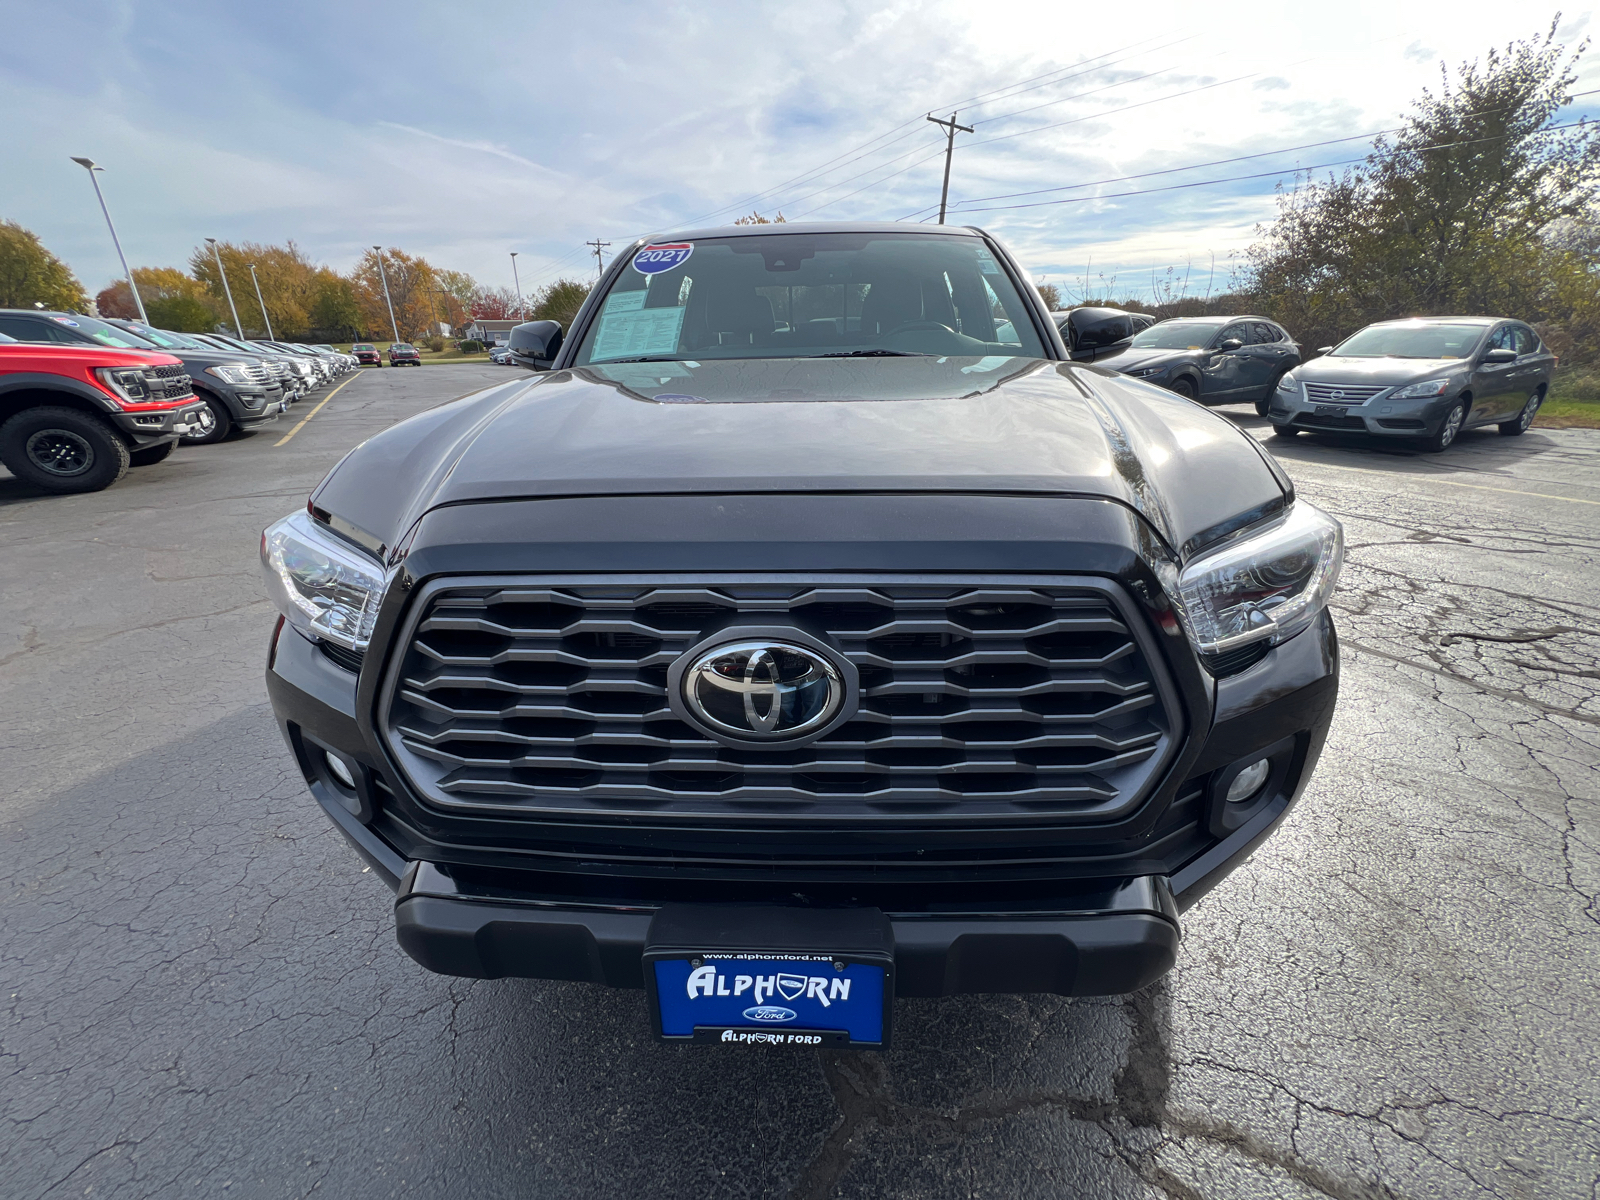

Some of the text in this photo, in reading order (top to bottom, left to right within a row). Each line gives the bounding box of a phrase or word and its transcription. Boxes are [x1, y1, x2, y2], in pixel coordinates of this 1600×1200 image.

[636, 250, 686, 263] 2021
[702, 953, 834, 962] www.alphornford.net
[754, 1008, 786, 1020] Ford
[787, 1034, 822, 1044] FORD
